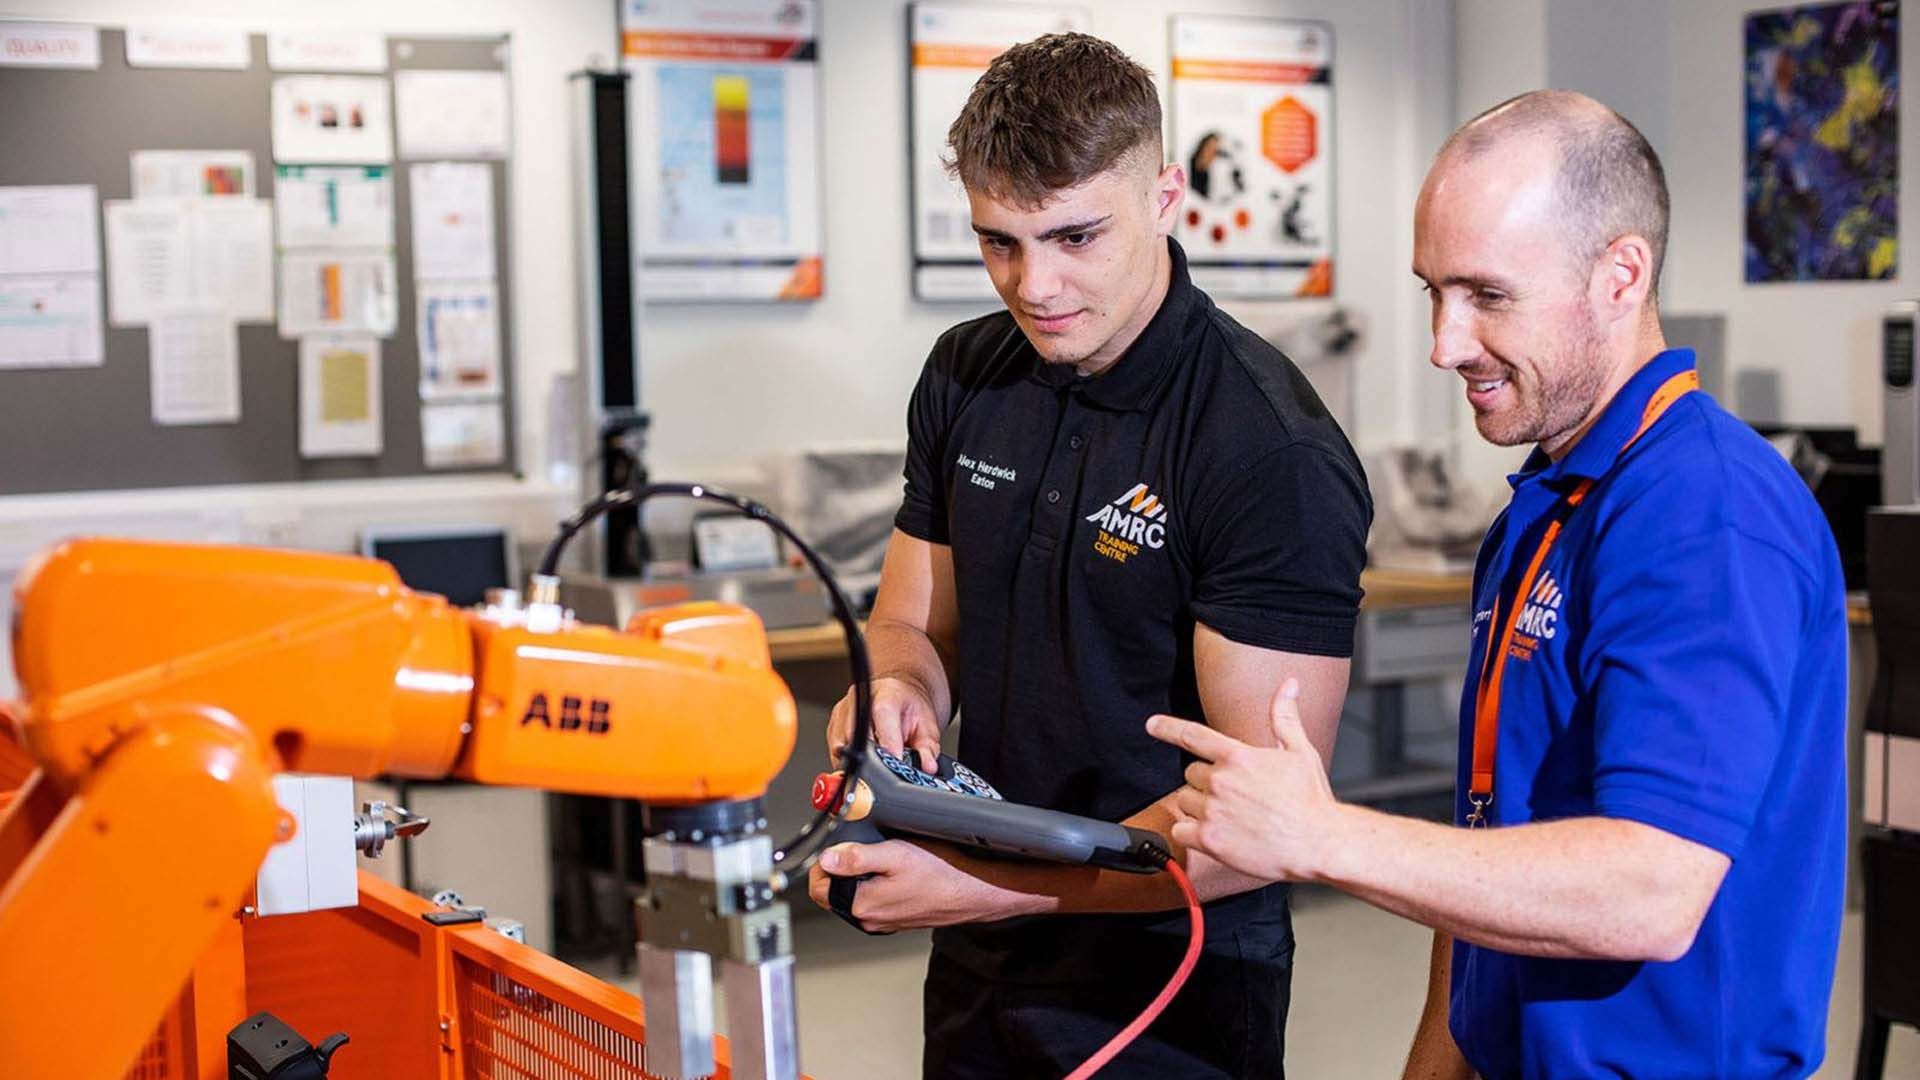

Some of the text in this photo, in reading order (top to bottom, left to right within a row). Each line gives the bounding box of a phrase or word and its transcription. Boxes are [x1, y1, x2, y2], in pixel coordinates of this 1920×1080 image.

[970, 473, 995, 490] Eaton
[977, 460, 1017, 482] Hardwick
[1085, 504, 1165, 549] AMRC
[1094, 541, 1128, 563] CENTRE
[1098, 530, 1139, 555] TRAINING
[521, 692, 610, 734] ABB
